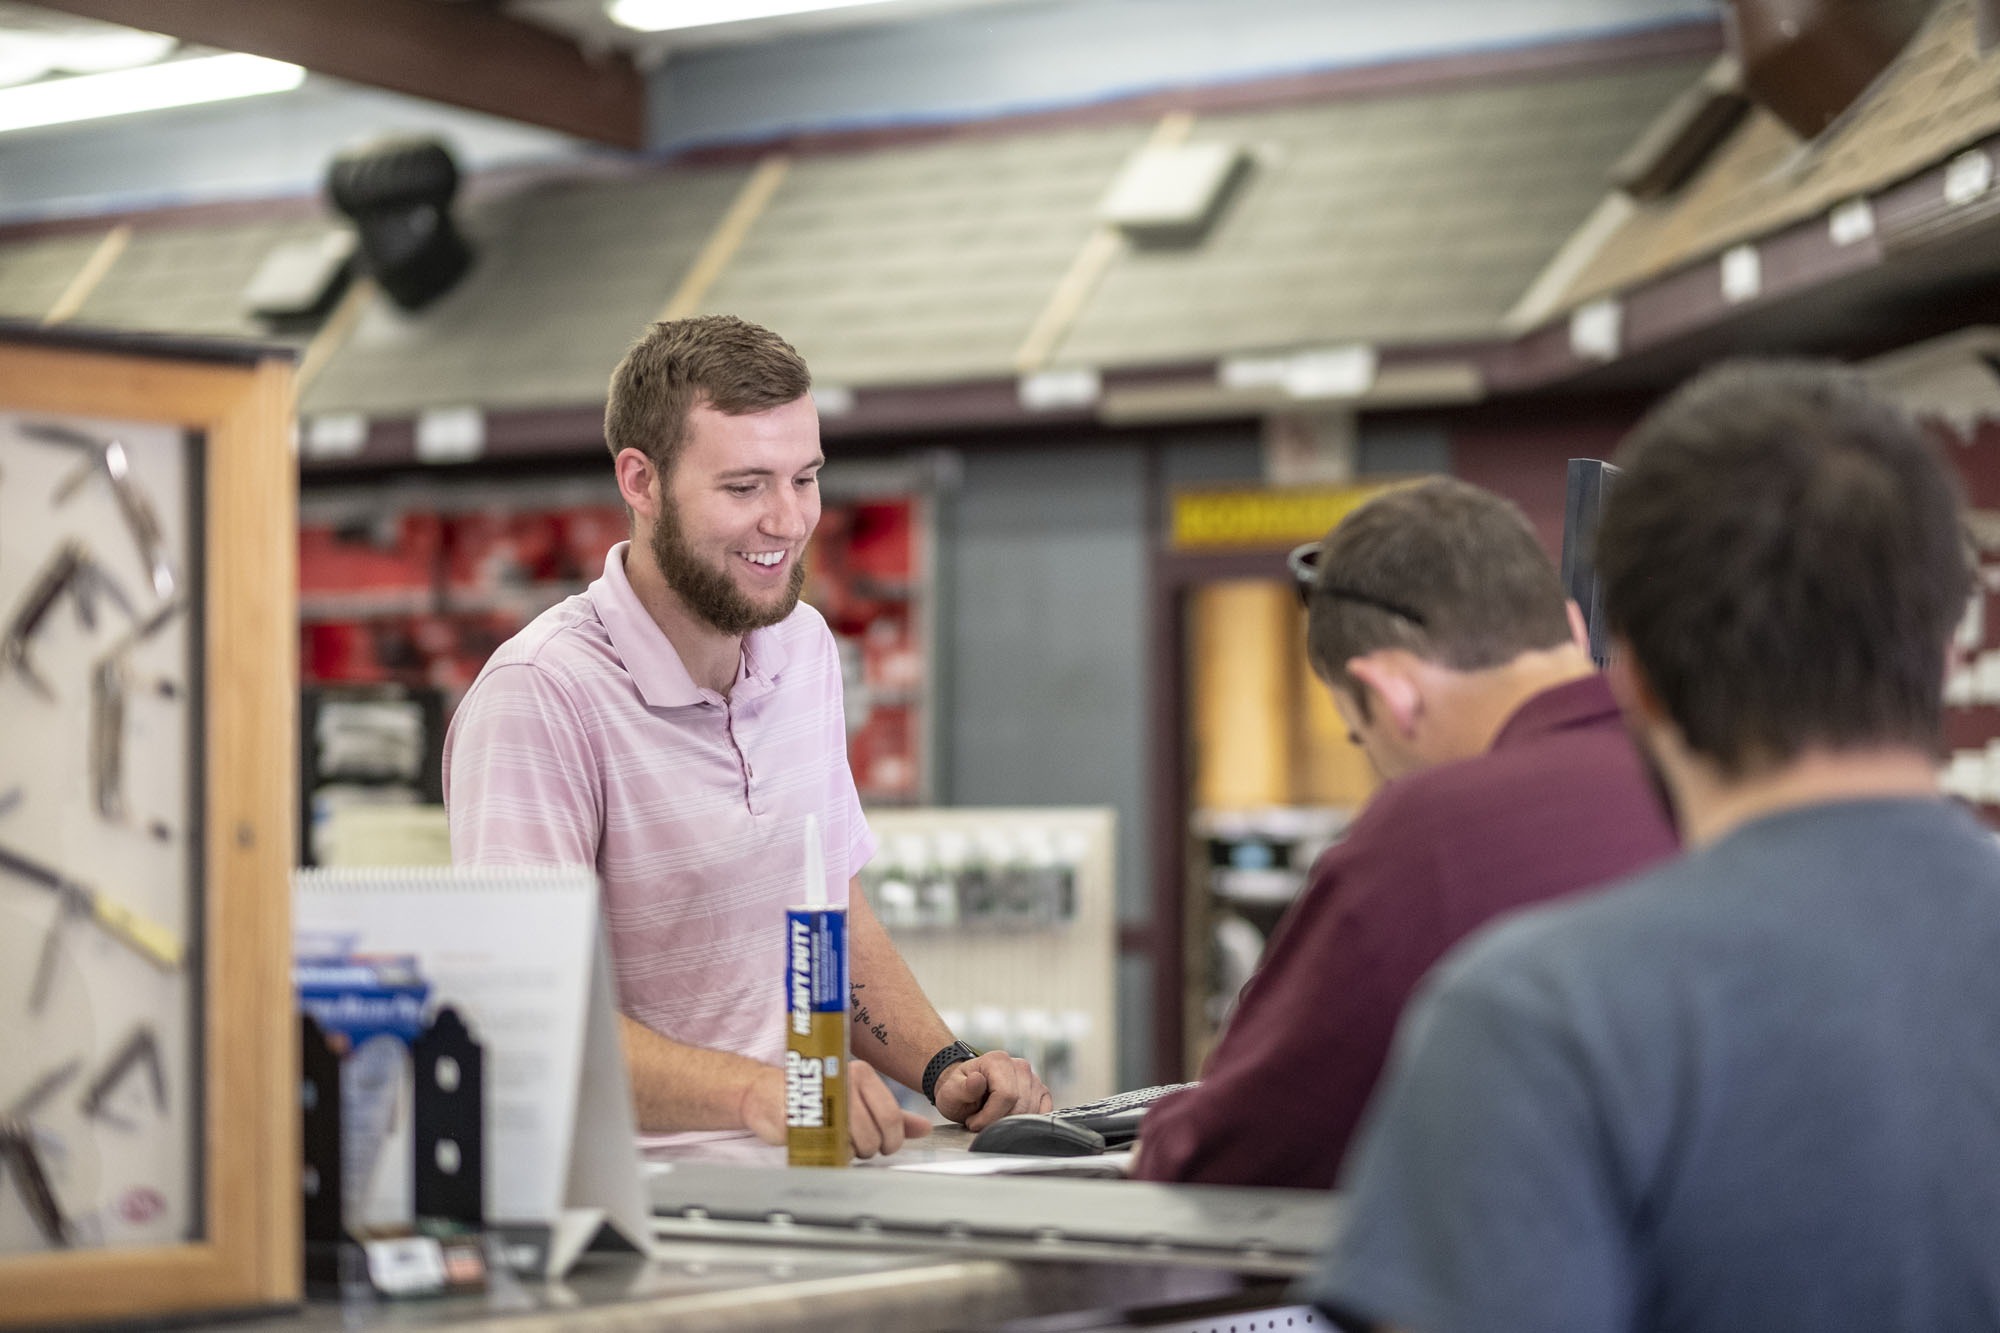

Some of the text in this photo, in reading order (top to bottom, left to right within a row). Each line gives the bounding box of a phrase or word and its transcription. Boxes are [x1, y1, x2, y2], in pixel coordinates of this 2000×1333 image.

[791, 919, 811, 1035] HEAVY DUTY
[799, 1057, 823, 1127] NAILS
